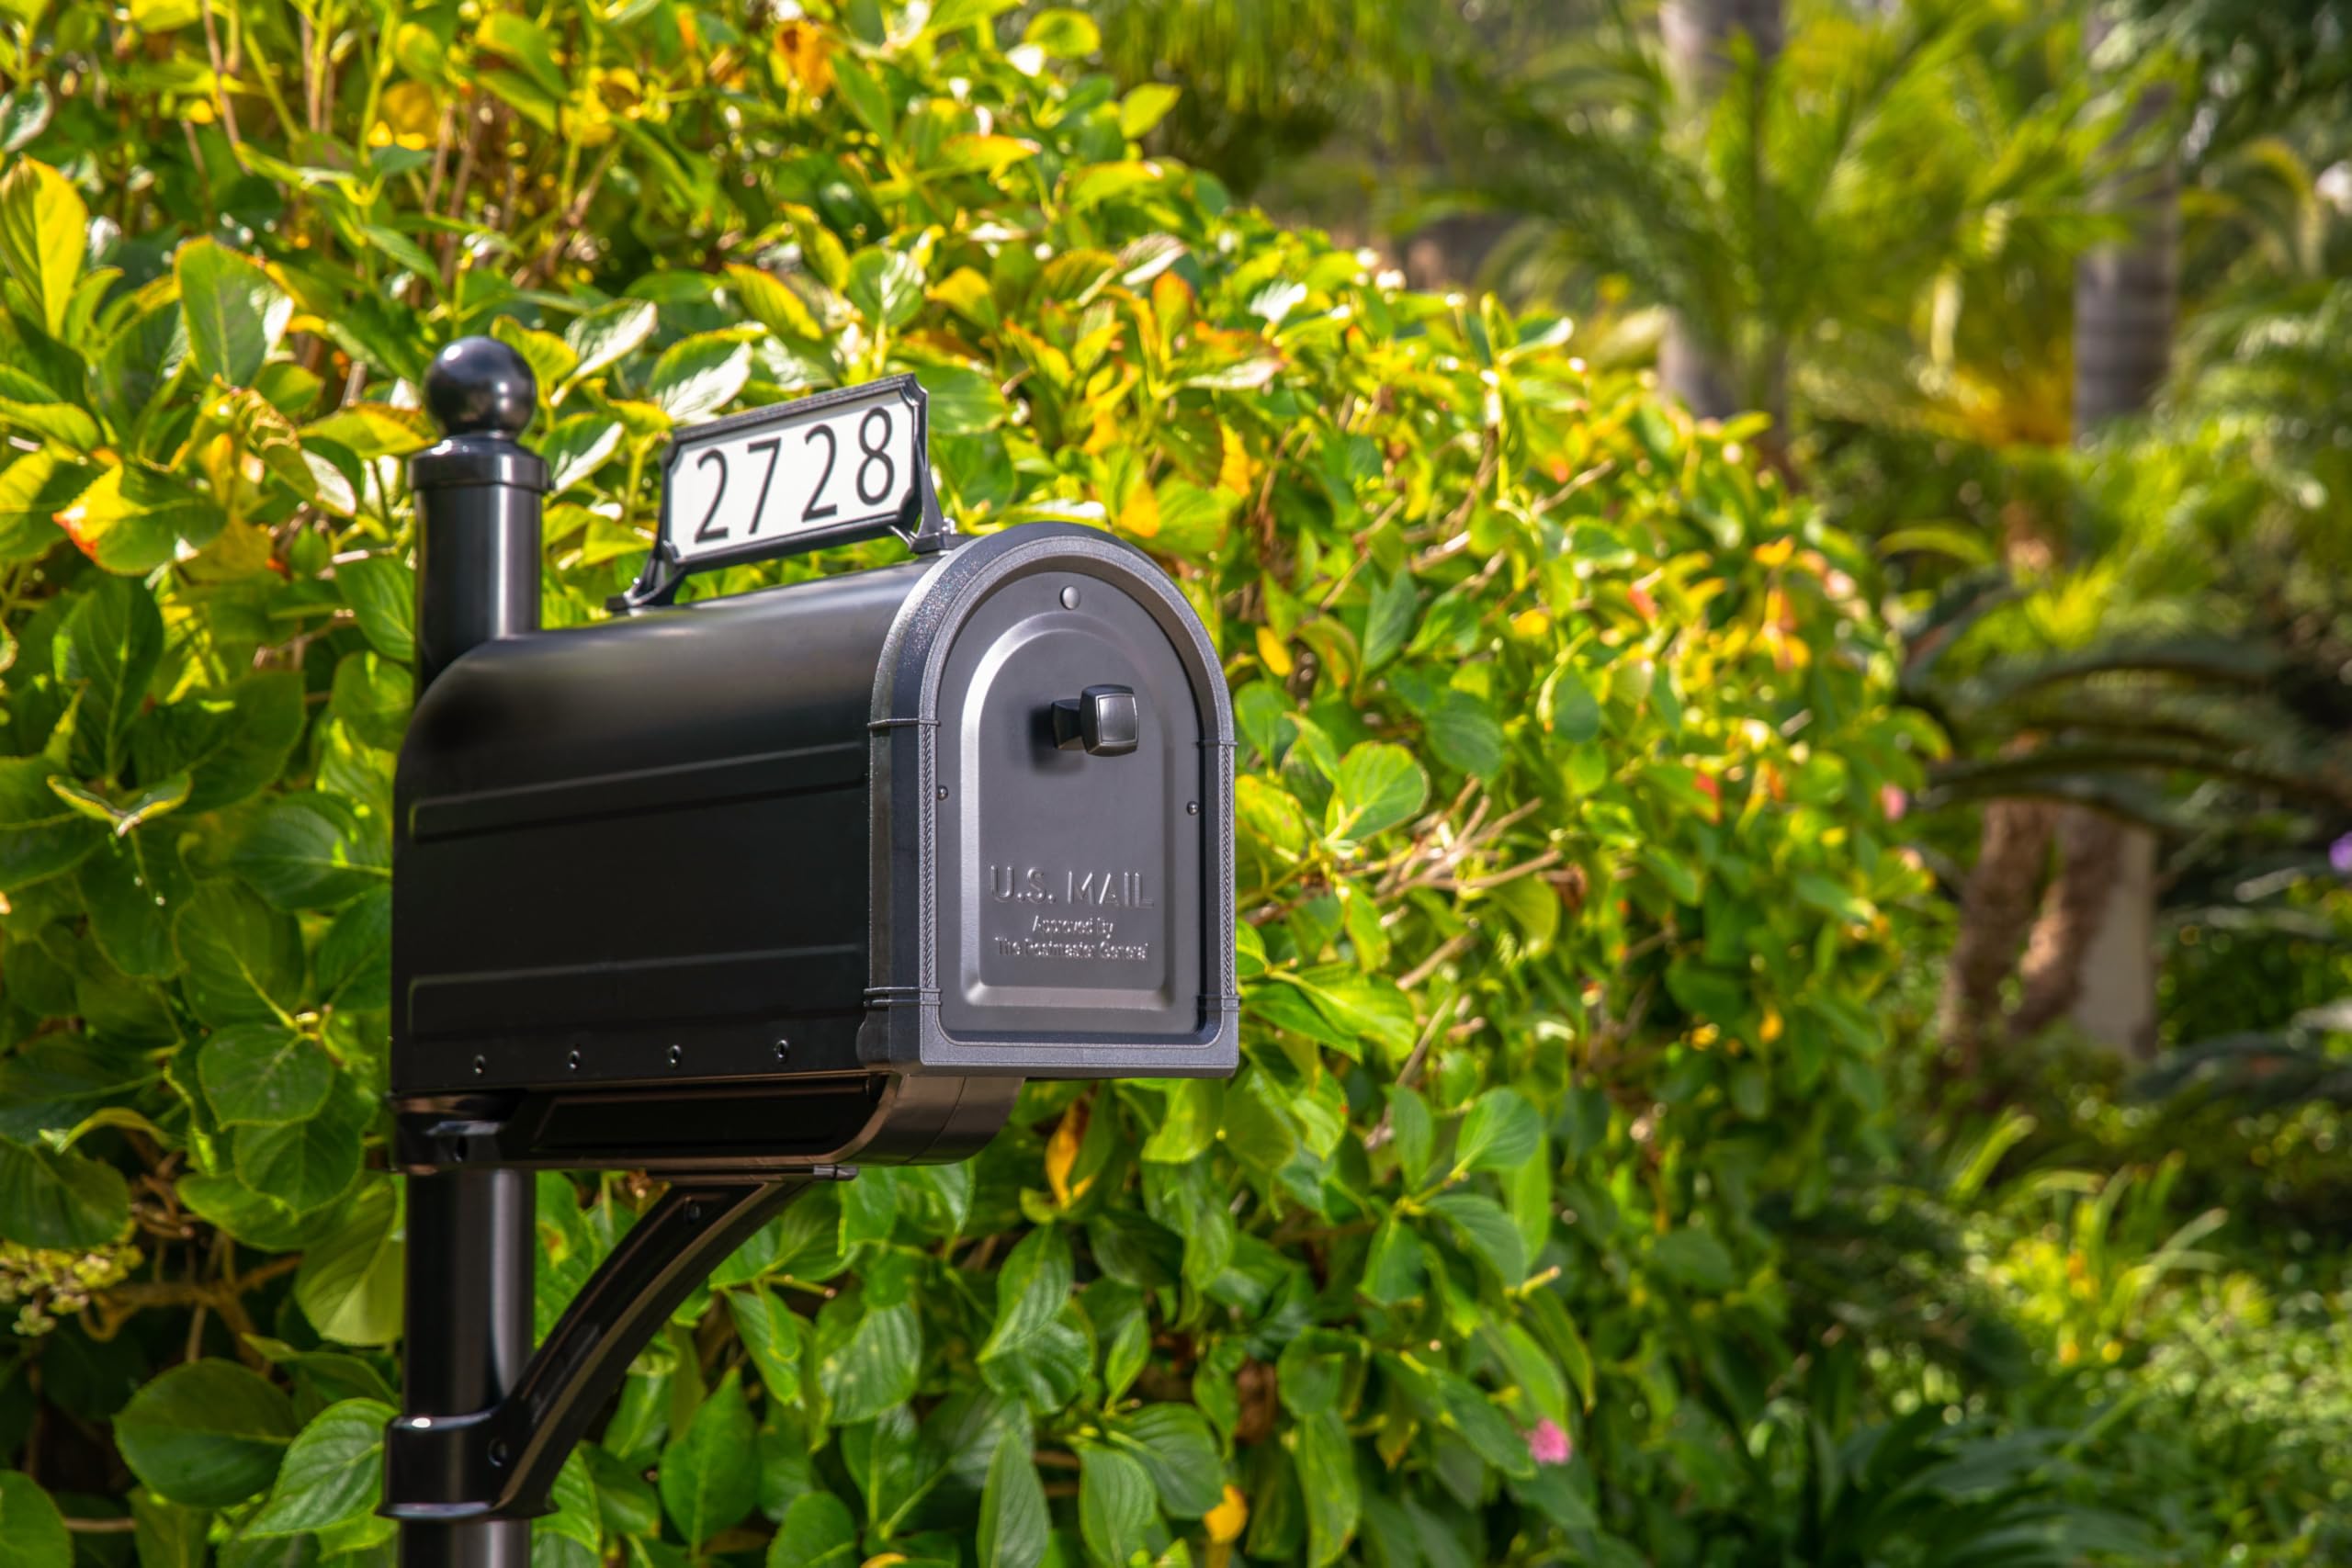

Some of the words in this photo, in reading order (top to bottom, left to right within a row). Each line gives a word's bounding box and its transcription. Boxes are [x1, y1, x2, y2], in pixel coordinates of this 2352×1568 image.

[695, 406, 895, 544] 2728
[990, 865, 1057, 903] U.S.
[1067, 871, 1154, 908] MAIL
[1032, 915, 1093, 938] Approved
[994, 934, 1023, 955] The
[1024, 937, 1096, 959] Postmaster
[1100, 941, 1149, 961] General
